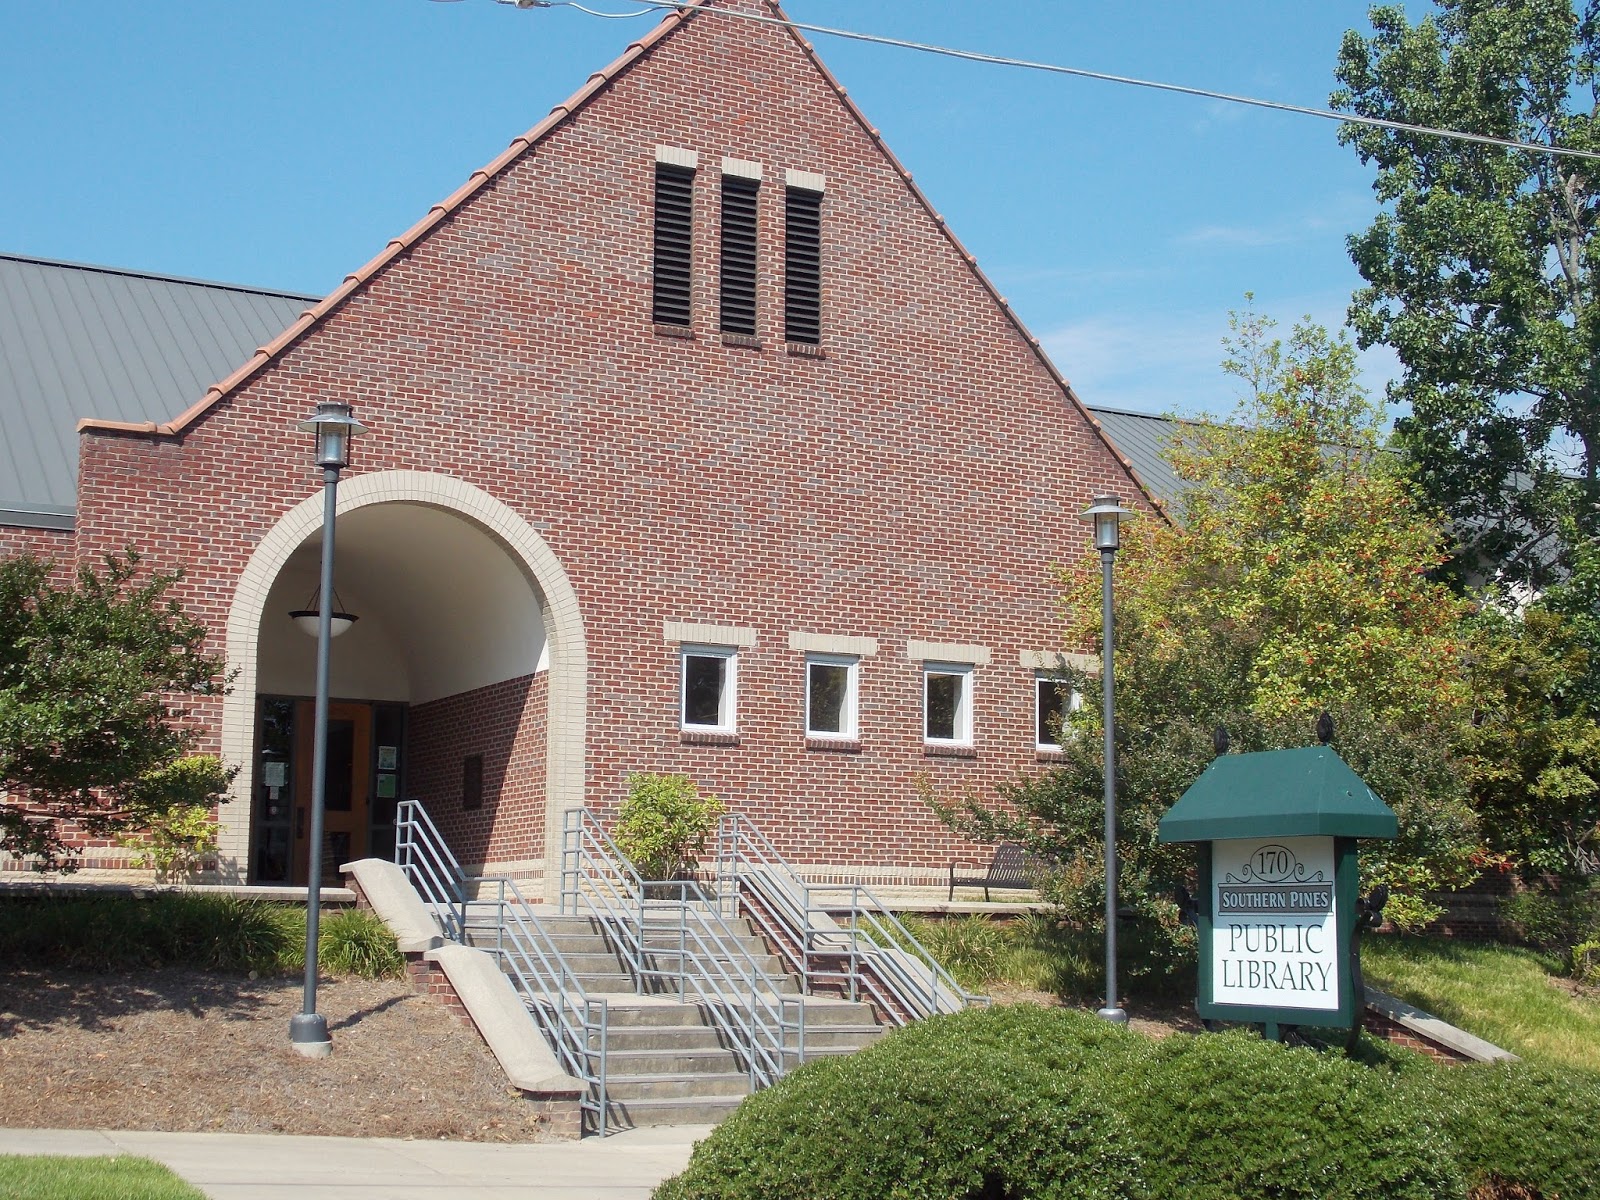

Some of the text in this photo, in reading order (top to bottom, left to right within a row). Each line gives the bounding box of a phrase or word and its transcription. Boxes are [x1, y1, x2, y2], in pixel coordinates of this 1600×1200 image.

[1258, 851, 1288, 874] 170
[1222, 891, 1329, 908] SOUTHERN PINES
[1228, 924, 1324, 954] PUBLIC
[1221, 959, 1332, 992] LIBRARY
